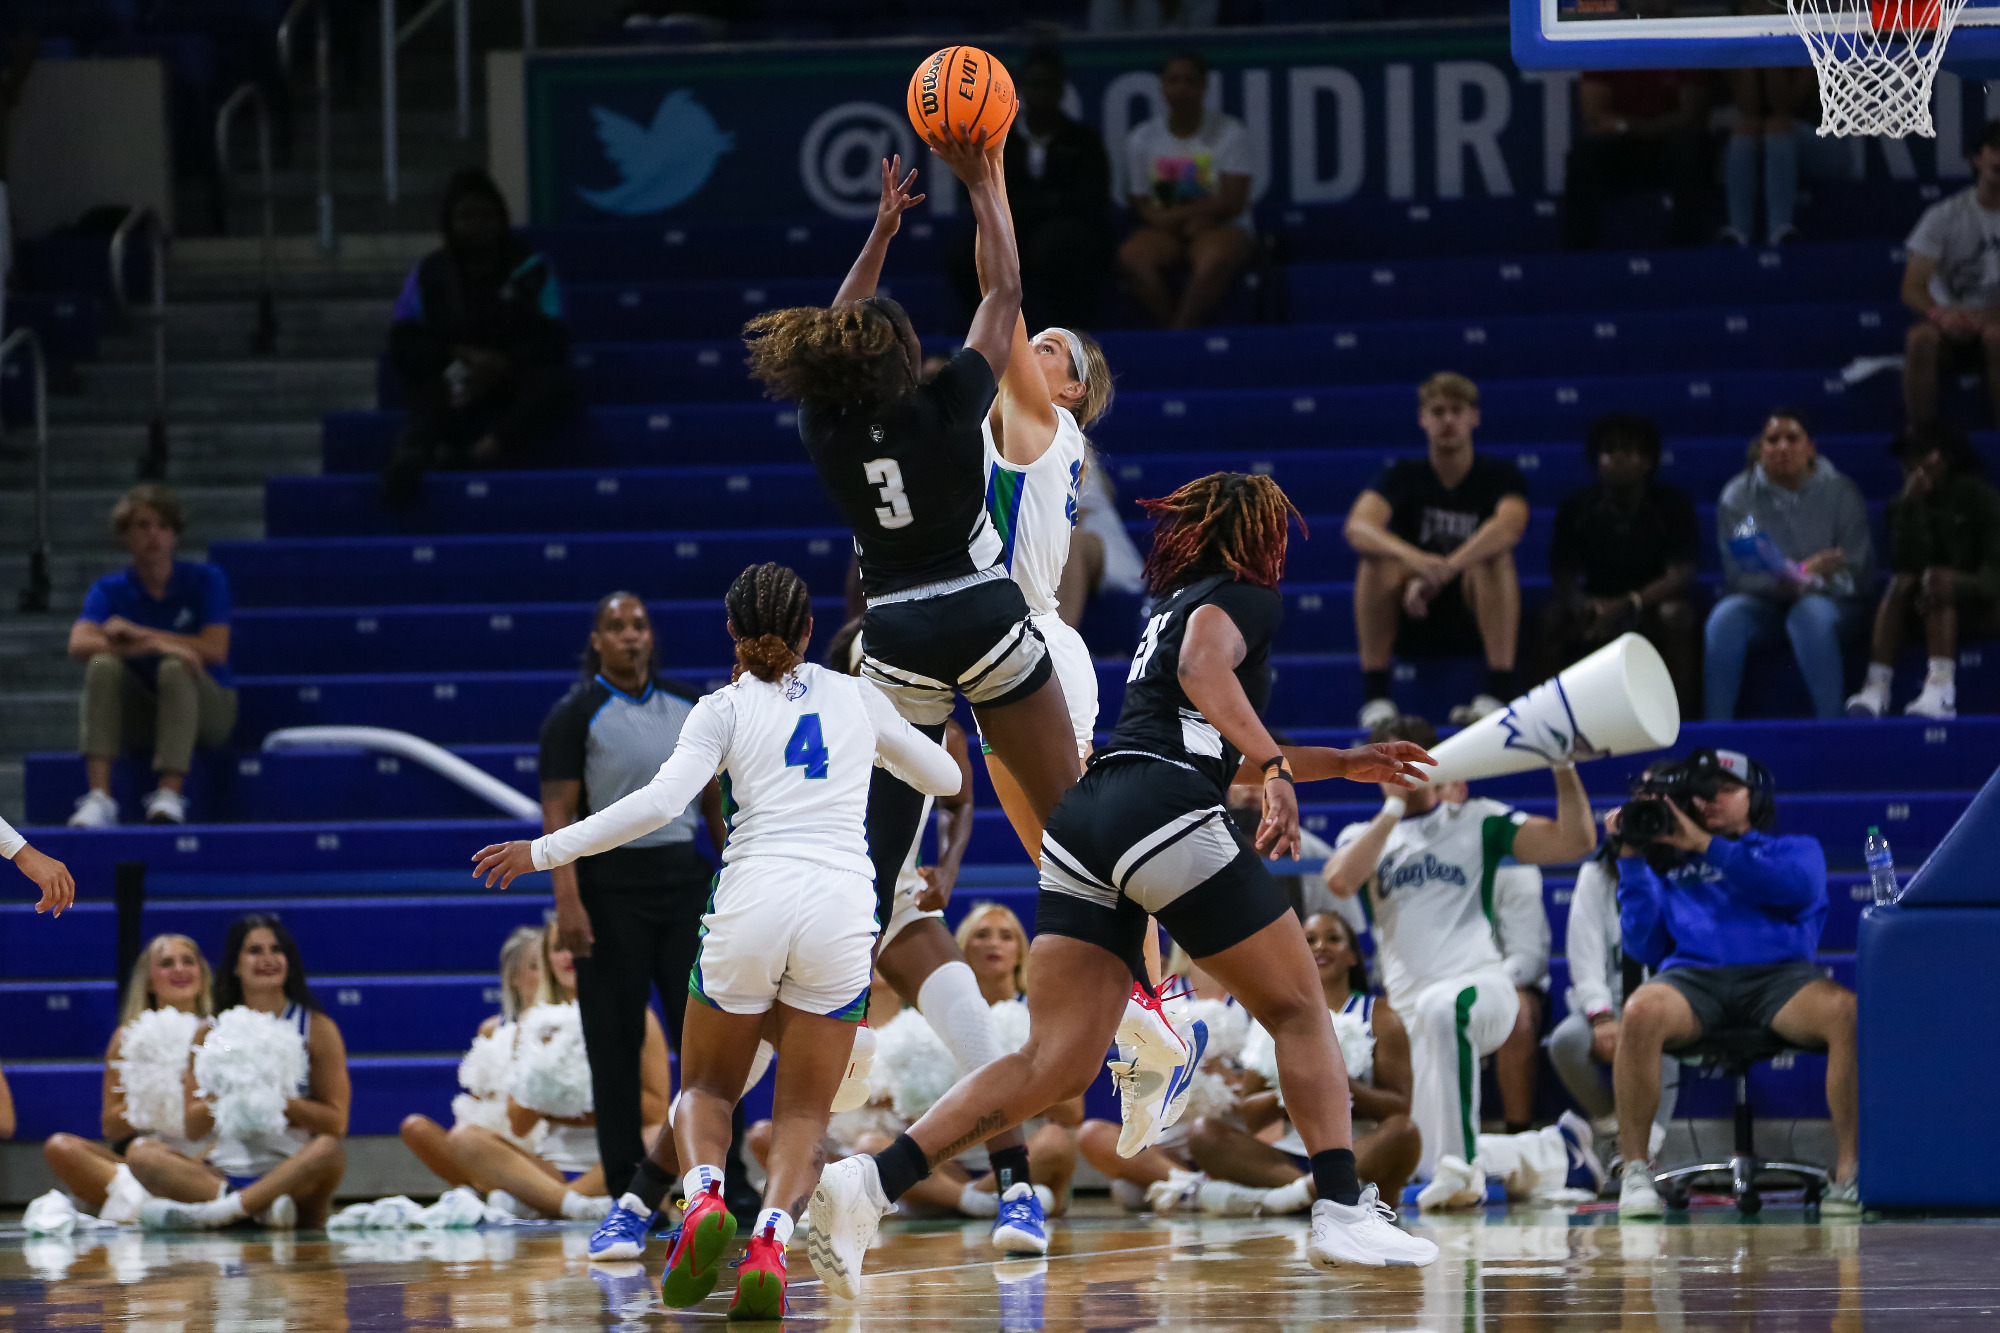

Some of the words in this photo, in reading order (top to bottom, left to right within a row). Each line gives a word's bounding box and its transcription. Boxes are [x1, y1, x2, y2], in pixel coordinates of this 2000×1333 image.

[922, 49, 951, 117] Wilson
[959, 58, 978, 101] EVO
[863, 458, 915, 529] 3
[784, 712, 829, 779] 4
[1377, 853, 1467, 900] Eagles
